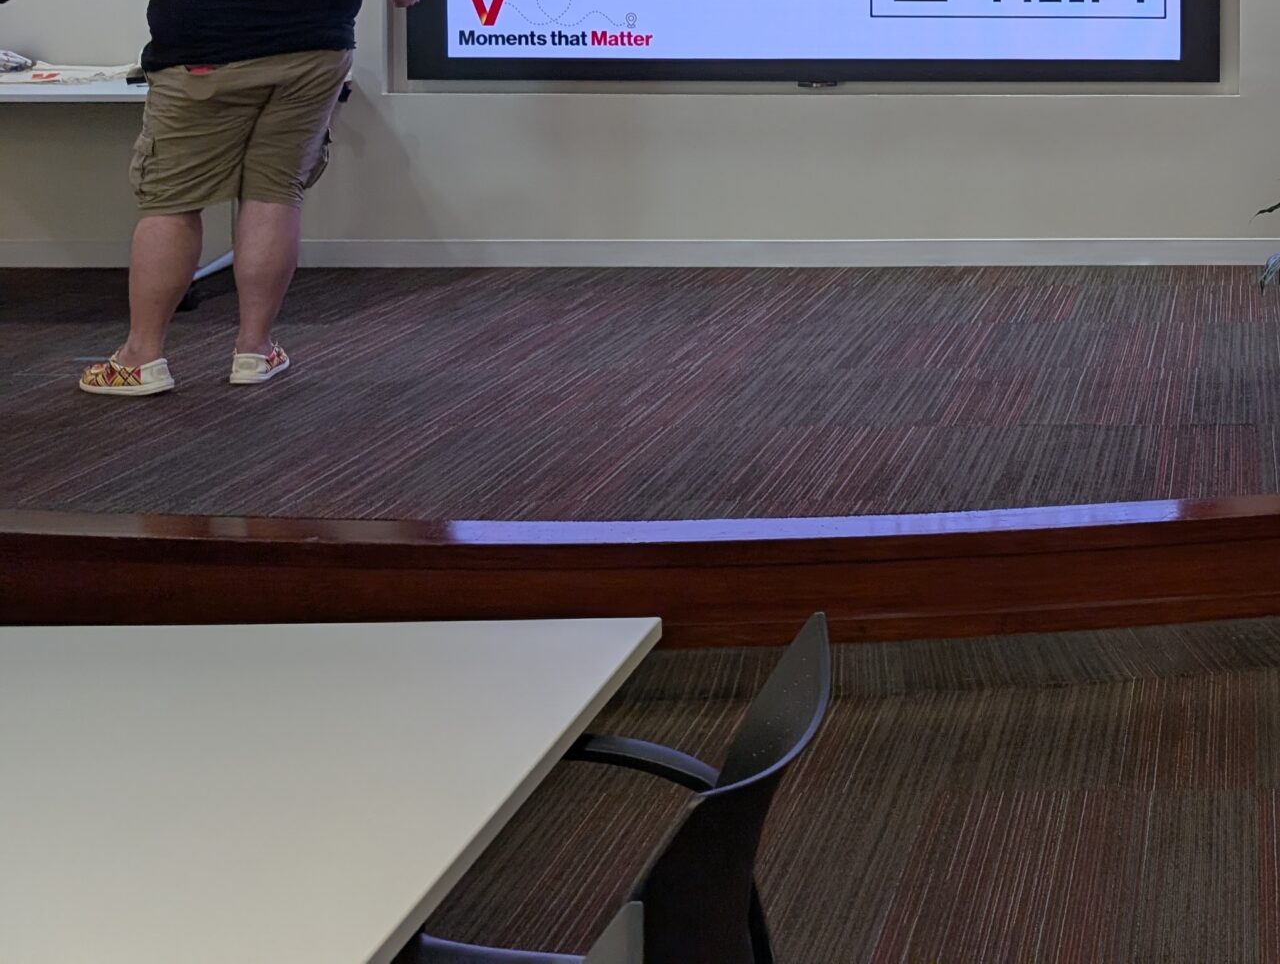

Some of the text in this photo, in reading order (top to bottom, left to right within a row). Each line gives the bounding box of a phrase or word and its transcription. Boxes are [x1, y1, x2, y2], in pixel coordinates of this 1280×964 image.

[458, 30, 653, 47] Moments that Matter
